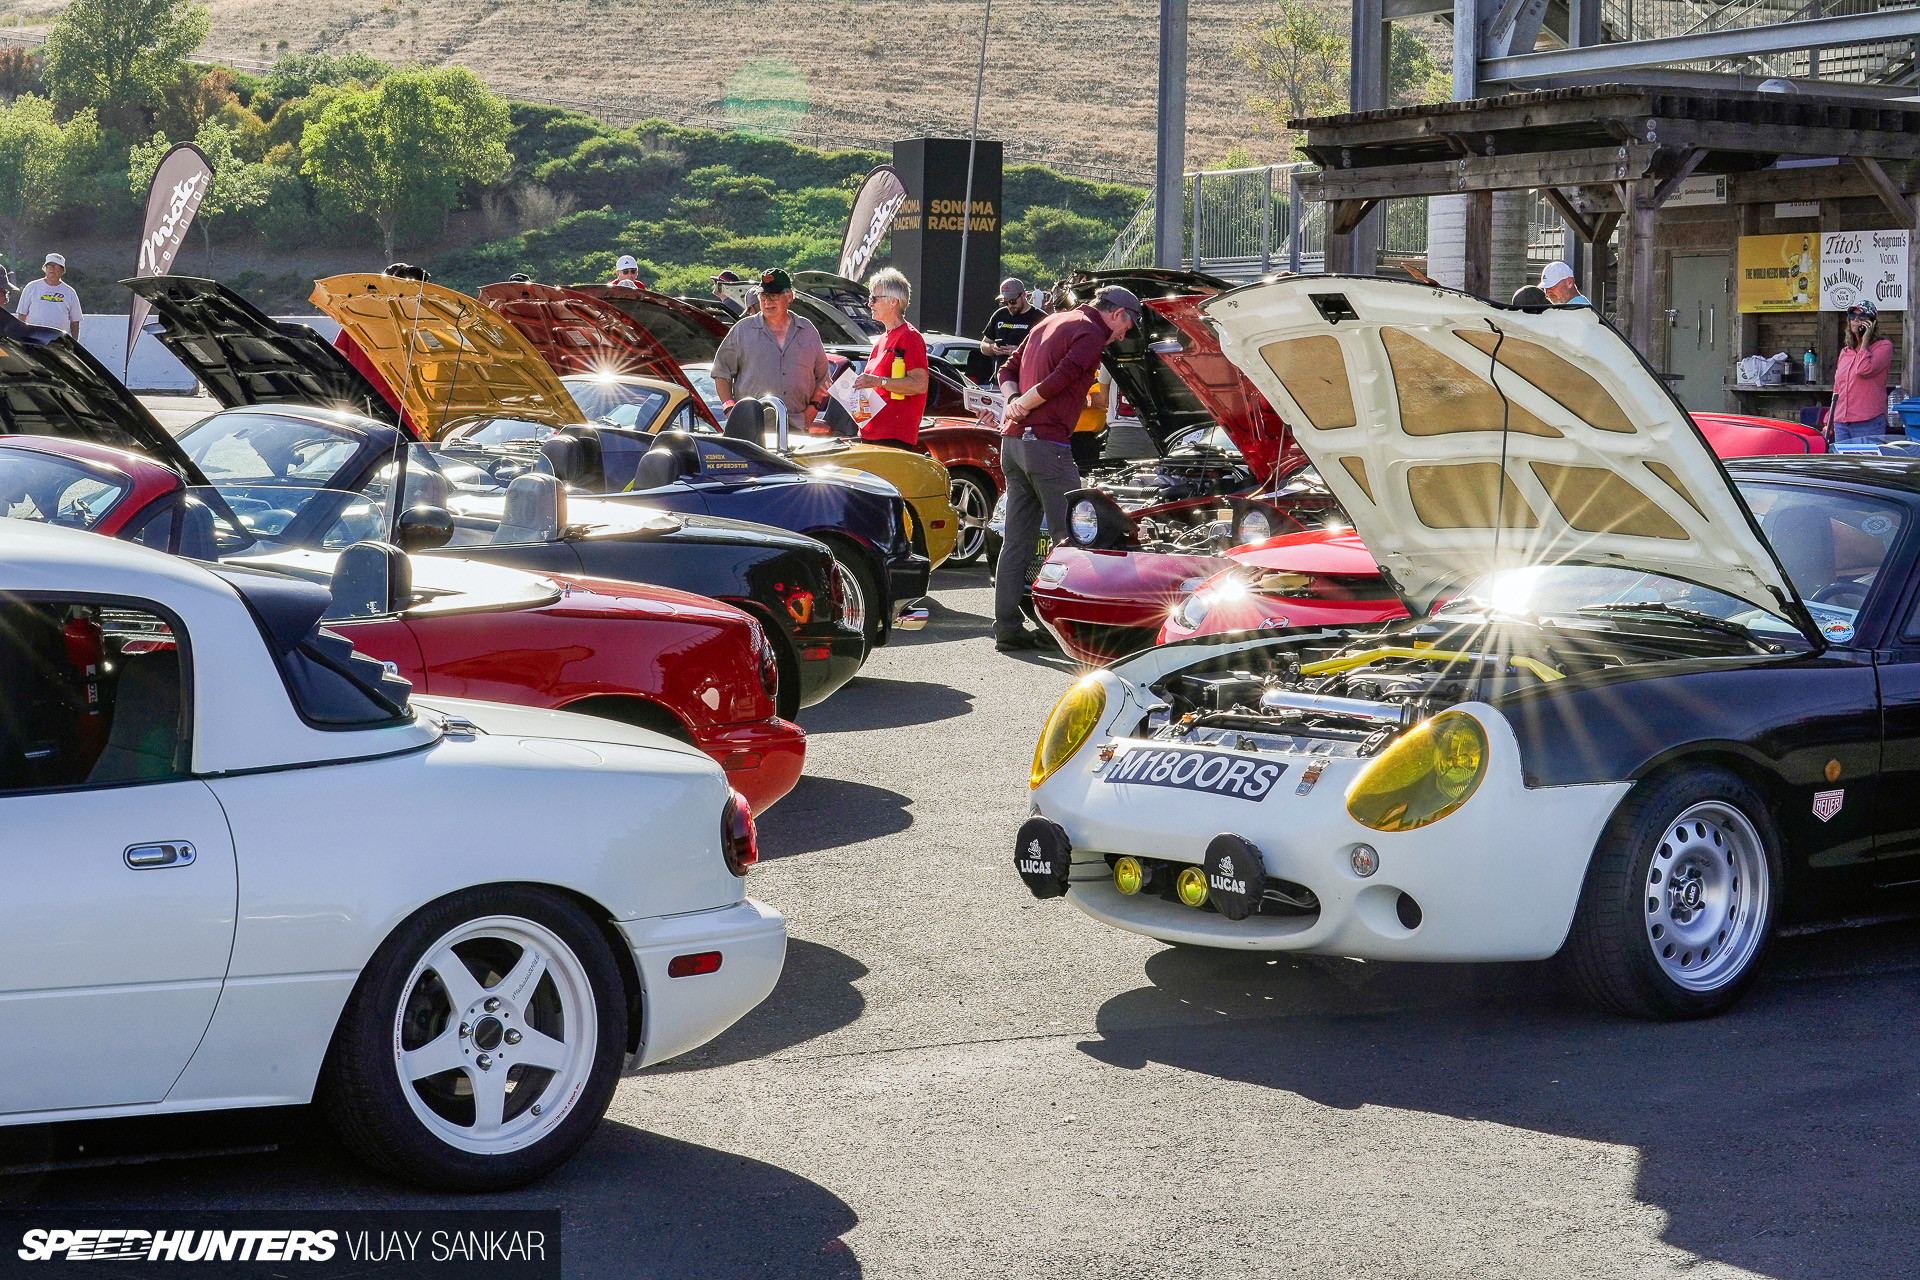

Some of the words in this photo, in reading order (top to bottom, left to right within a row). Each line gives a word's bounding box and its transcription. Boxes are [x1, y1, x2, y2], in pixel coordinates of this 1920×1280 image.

[931, 199, 994, 215] SONOMA
[893, 215, 921, 231] RACEWAY
[928, 216, 997, 231] RACEWAY
[1825, 233, 1861, 255] Tito's
[1873, 232, 1906, 251] Seagram's
[1823, 272, 1840, 291] JACK
[1839, 267, 1865, 292] DANIEL'S
[1876, 279, 1902, 302] Cuervo
[1109, 750, 1279, 797] M1800RS
[1816, 798, 1841, 817] HEUER
[1020, 859, 1051, 874] LUCAS
[1210, 874, 1247, 894] LUCAS
